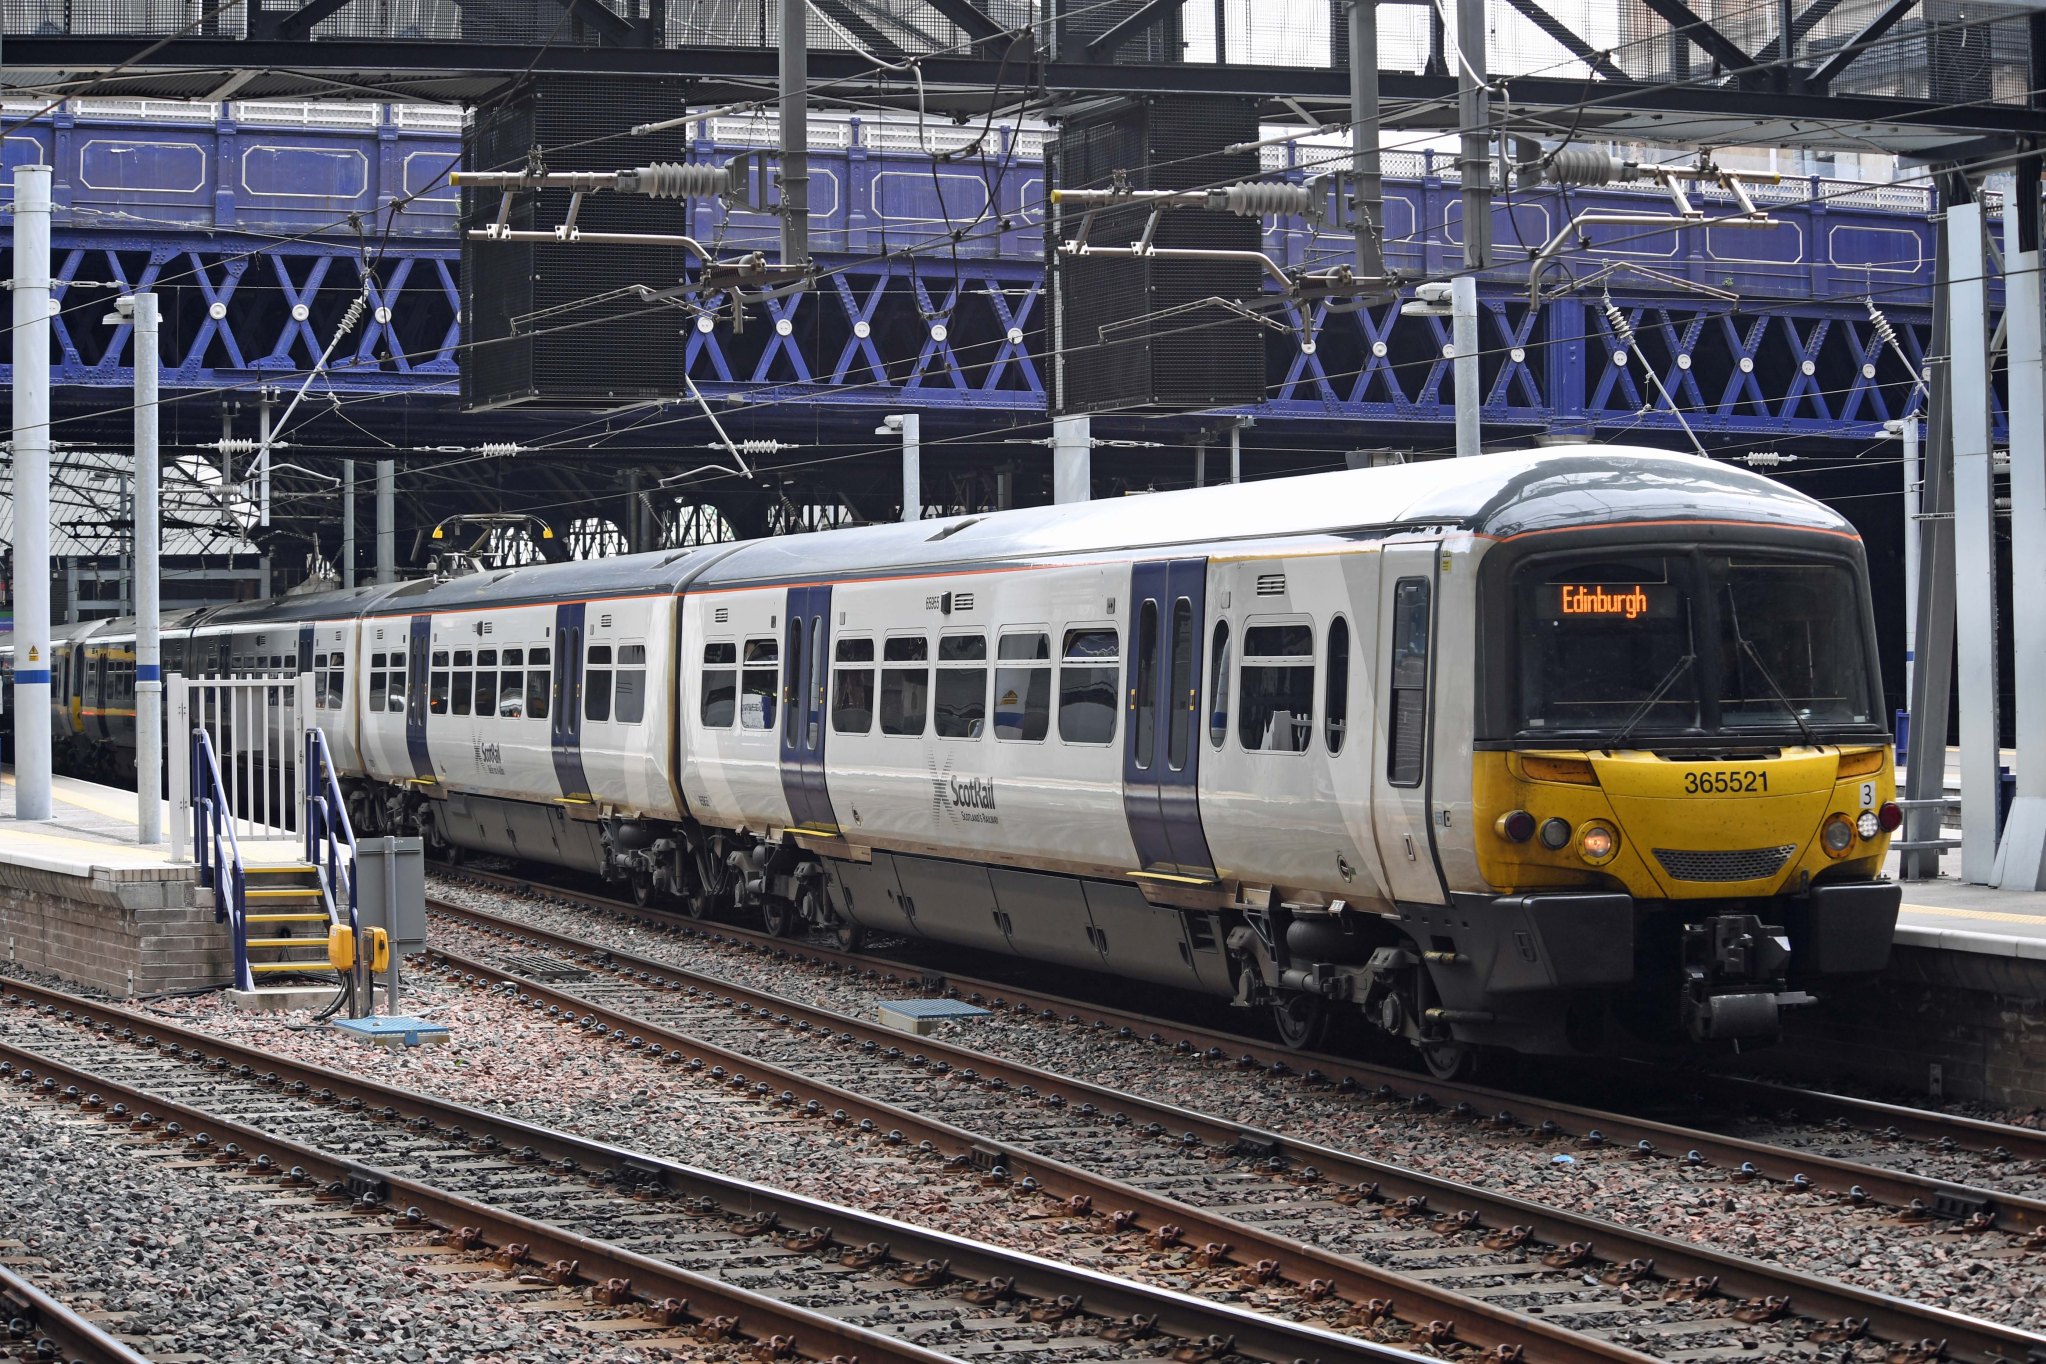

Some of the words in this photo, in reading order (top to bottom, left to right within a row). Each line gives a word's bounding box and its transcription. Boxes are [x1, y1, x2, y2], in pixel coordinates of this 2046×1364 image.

[1562, 585, 1647, 619] Edinburgh
[950, 775, 996, 810] ScotRail
[1684, 771, 1768, 794] 365521
[1863, 784, 1872, 805] 3
